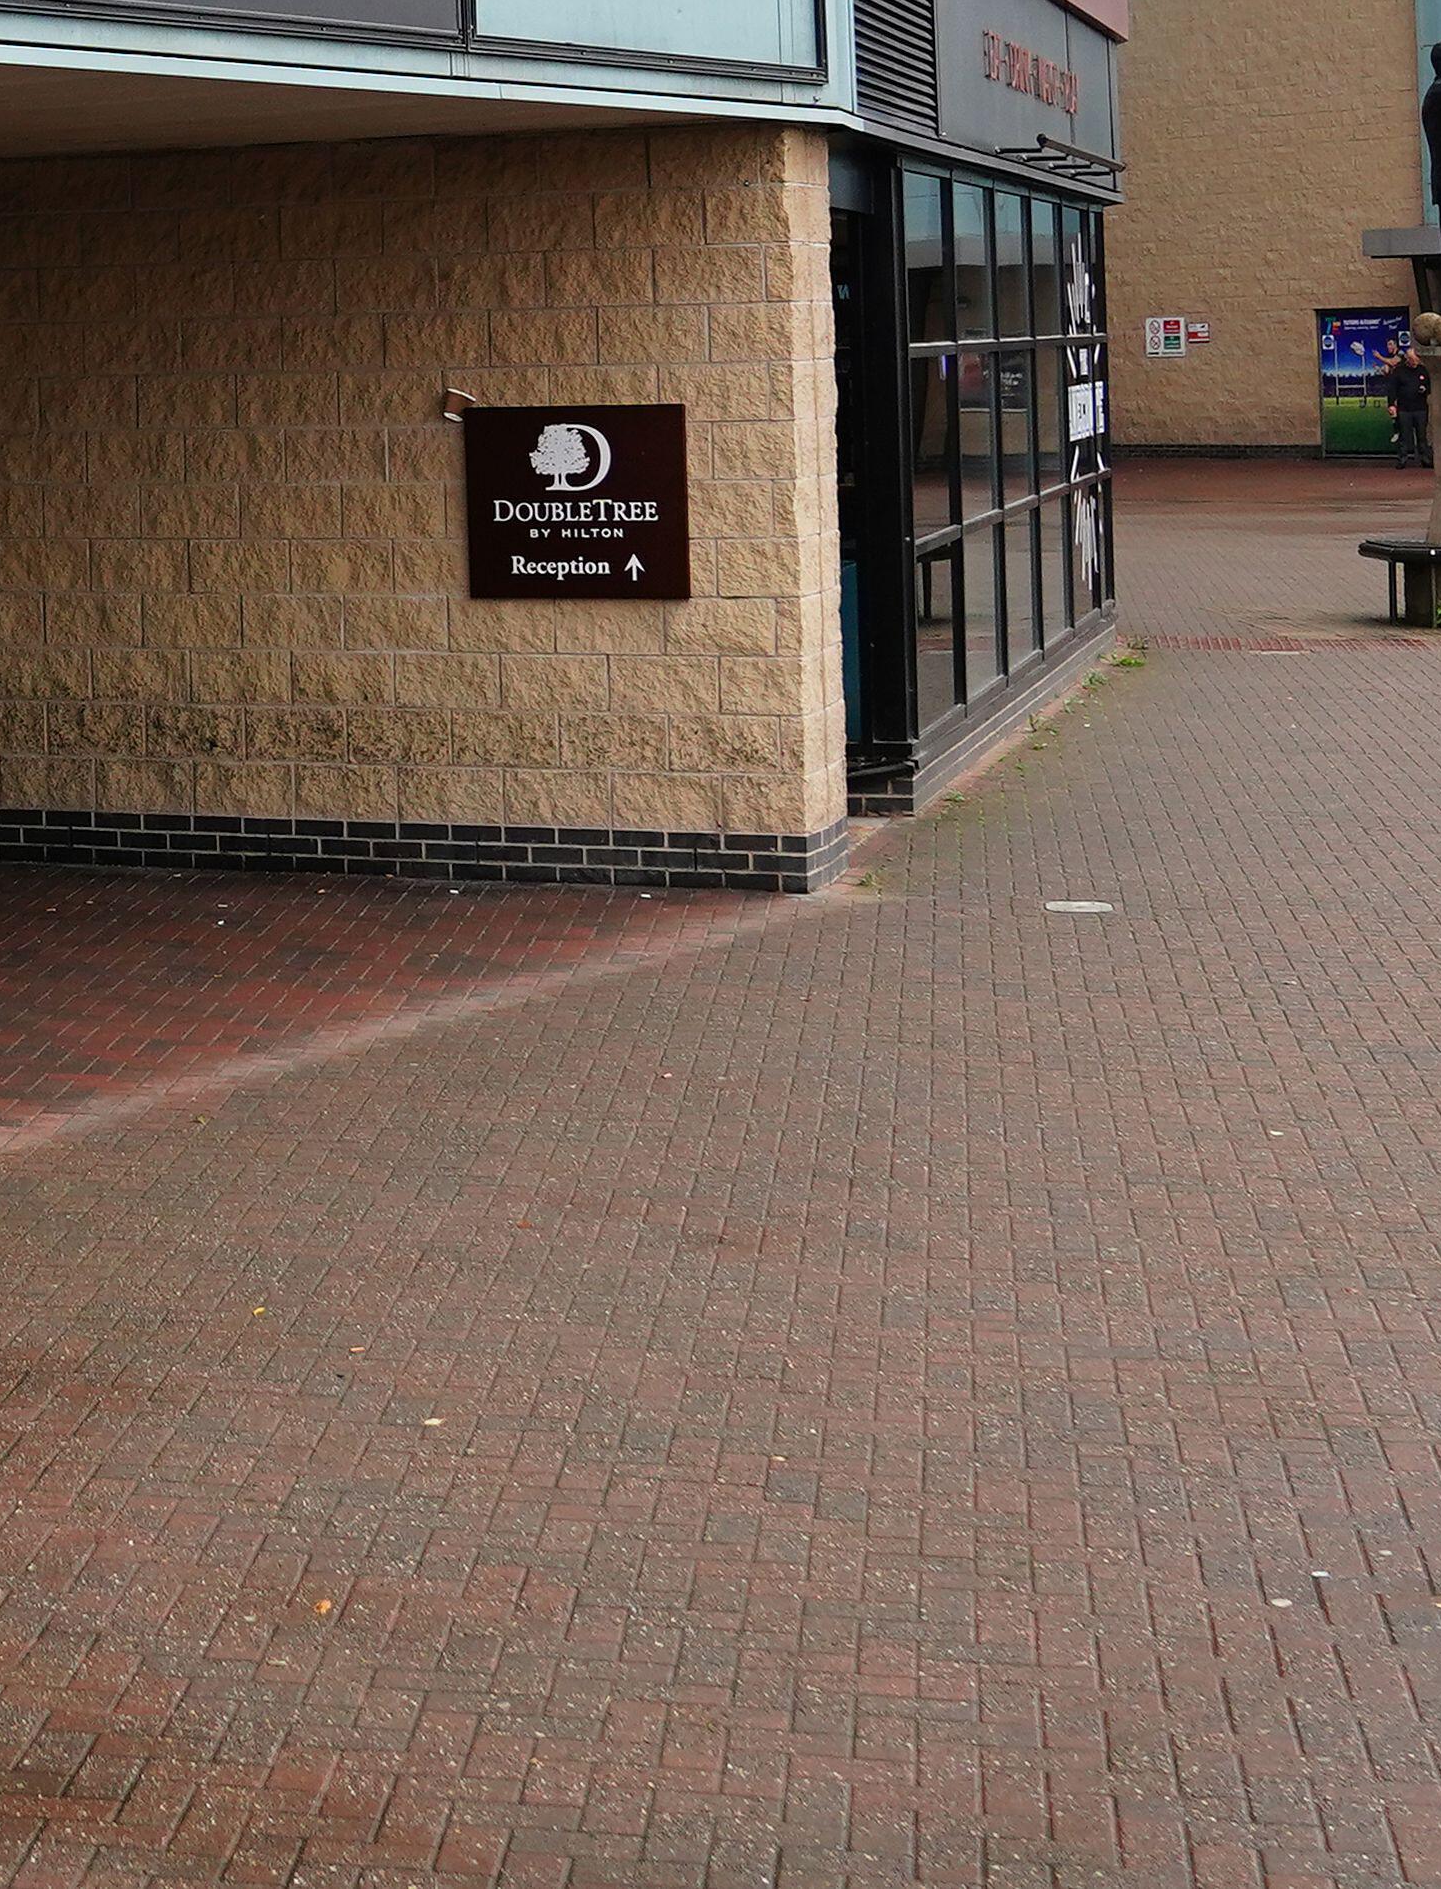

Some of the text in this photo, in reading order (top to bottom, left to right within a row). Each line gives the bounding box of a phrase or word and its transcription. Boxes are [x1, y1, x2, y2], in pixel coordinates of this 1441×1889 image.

[493, 499, 659, 523] DOUBLETREE
[529, 528, 624, 539] BY HILTON
[511, 554, 611, 581] Reception
